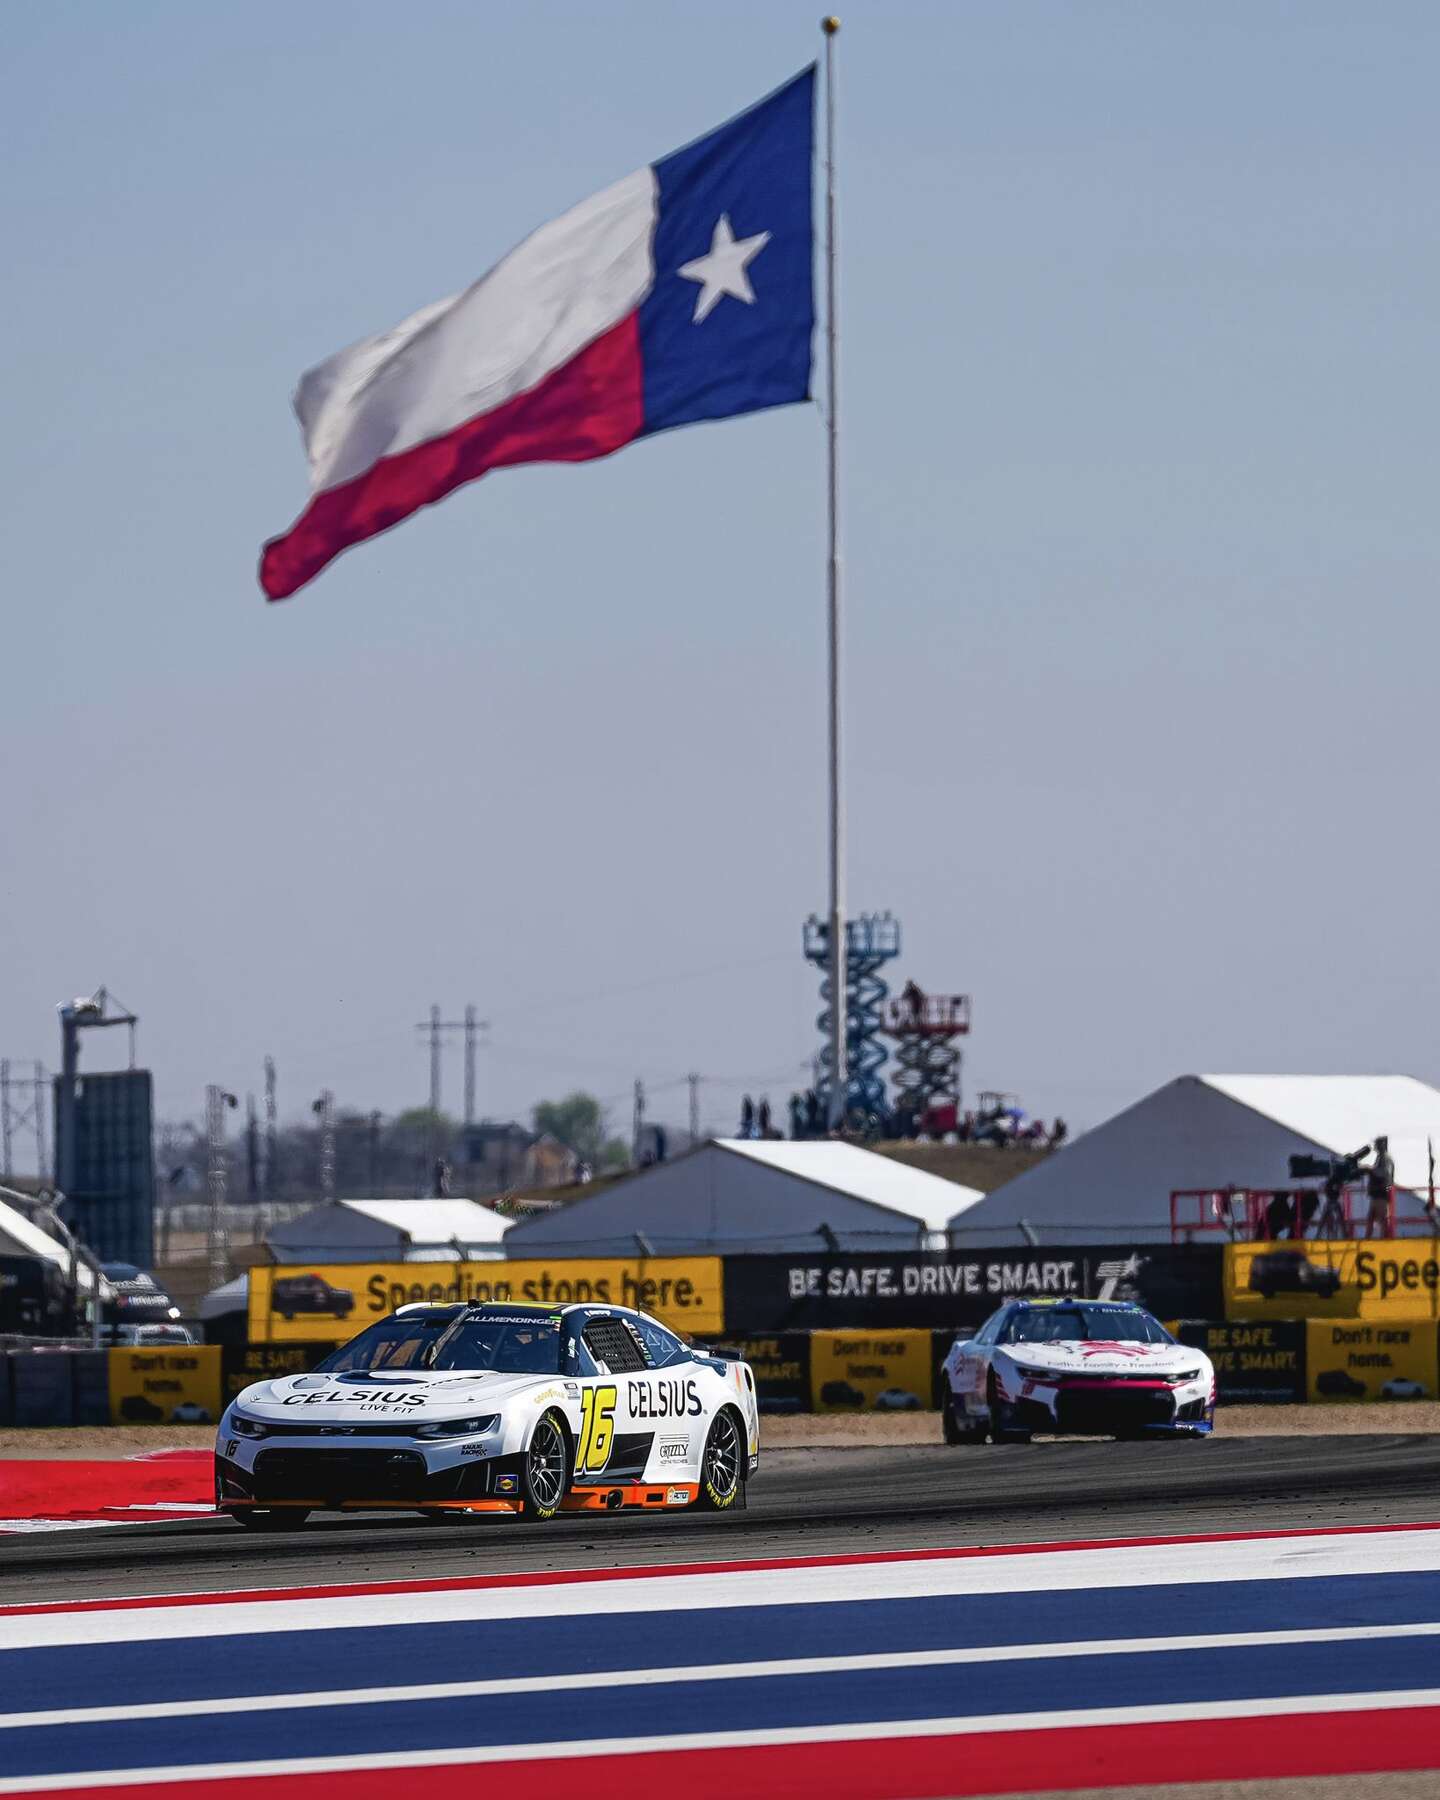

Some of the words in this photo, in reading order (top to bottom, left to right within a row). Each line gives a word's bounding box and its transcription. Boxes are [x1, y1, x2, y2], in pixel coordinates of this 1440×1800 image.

[622, 1268, 703, 1306] here.
[788, 1268, 820, 1298] BE
[827, 1267, 898, 1298] SAFE.
[903, 1264, 981, 1296] DRIVE
[986, 1261, 1077, 1292] SMART.
[1332, 1327, 1373, 1345] Don't
[1377, 1331, 1411, 1345] race
[282, 1390, 426, 1406] CELSIUS
[359, 1404, 389, 1413] LIVE
[628, 1380, 703, 1418] CELSIUS
[575, 1385, 618, 1474] 16
[225, 1441, 241, 1457] 16
